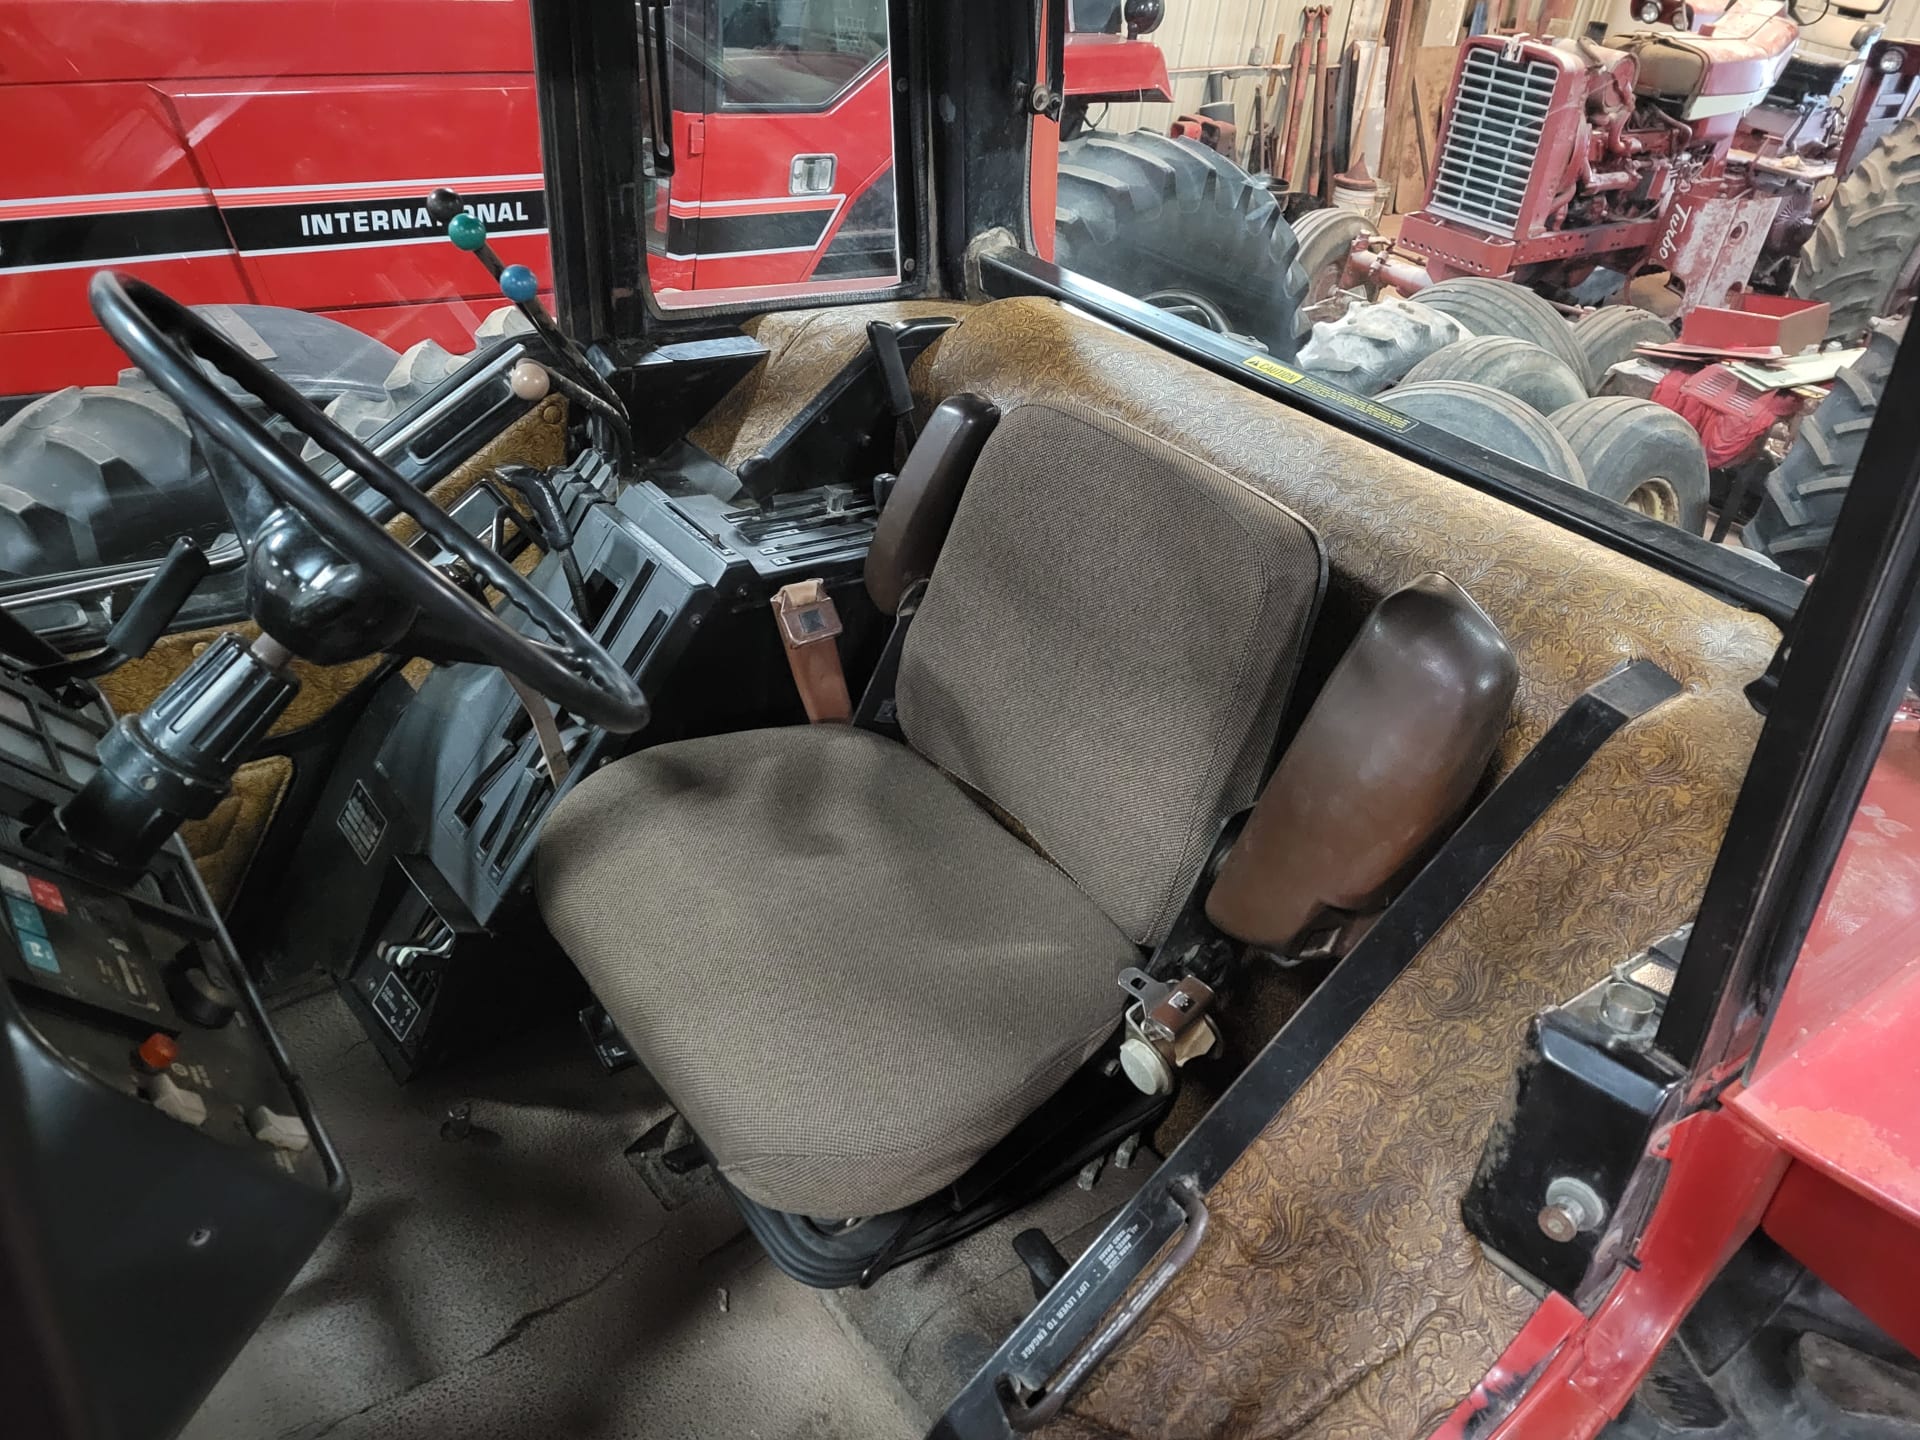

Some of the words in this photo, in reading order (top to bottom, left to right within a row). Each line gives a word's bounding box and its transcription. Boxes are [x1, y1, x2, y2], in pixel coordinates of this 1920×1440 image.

[301, 202, 528, 236] INTERNANAL
[1660, 203, 1692, 259] Turbo
[1259, 362, 1297, 381] CAUTION
[1075, 1280, 1090, 1297] LIFT
[1056, 1295, 1077, 1318] LEVER
[1046, 1317, 1057, 1329] TO
[1020, 1328, 1048, 1359] ENGAGE
